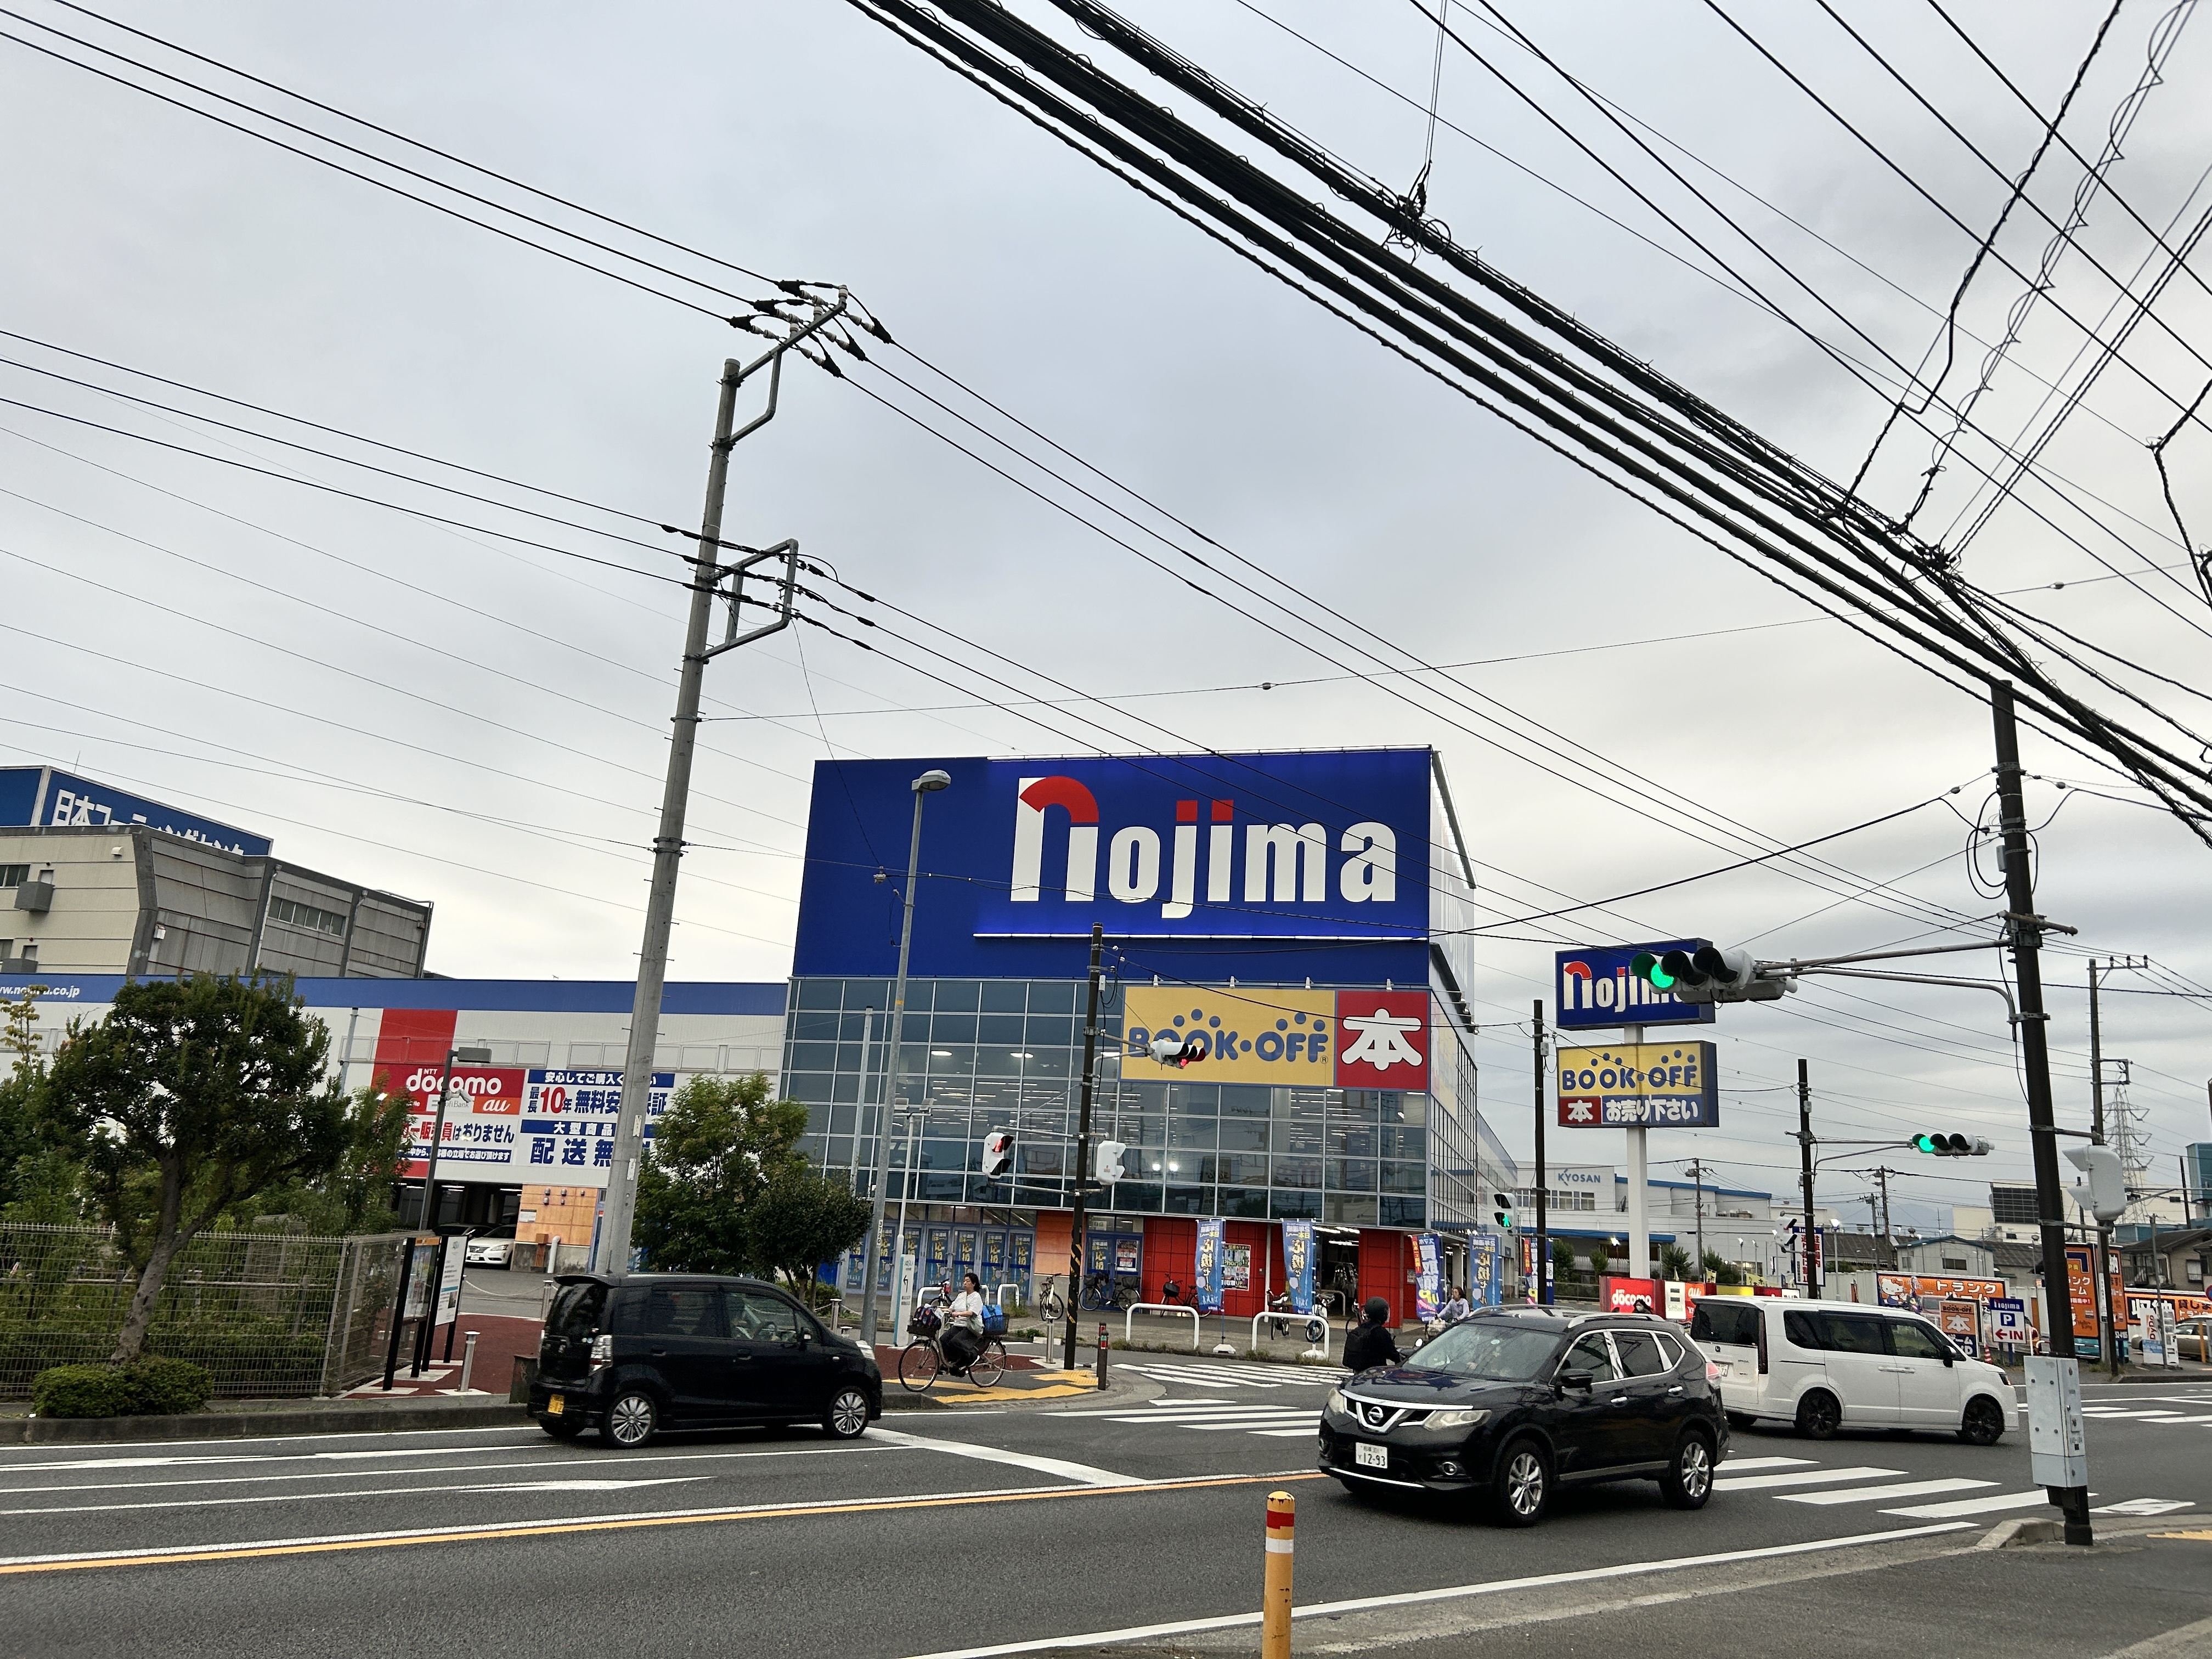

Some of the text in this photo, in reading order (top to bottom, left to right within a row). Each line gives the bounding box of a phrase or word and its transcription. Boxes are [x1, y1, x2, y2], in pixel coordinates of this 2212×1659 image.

[1011, 776, 1396, 919] nojima
[1342, 1008, 1424, 1071] 本
[545, 1071, 657, 1085] 安心してご購入くい
[445, 1099, 469, 1108] oftBank
[483, 1099, 511, 1112] au
[527, 1086, 540, 1113] 最長
[1568, 1098, 1699, 1123] 本 お売り下さい
[530, 1137, 650, 1167] 配送無
[1558, 1168, 1601, 1186] KYOSAN
[1937, 1280, 1996, 1295] トランク
[1994, 1299, 2020, 1310] nojima
[1946, 1314, 1971, 1332] 本
[2003, 1314, 2012, 1325] P
[2009, 1330, 2023, 1340] IN
[1363, 1452, 1385, 1466] 12-93
